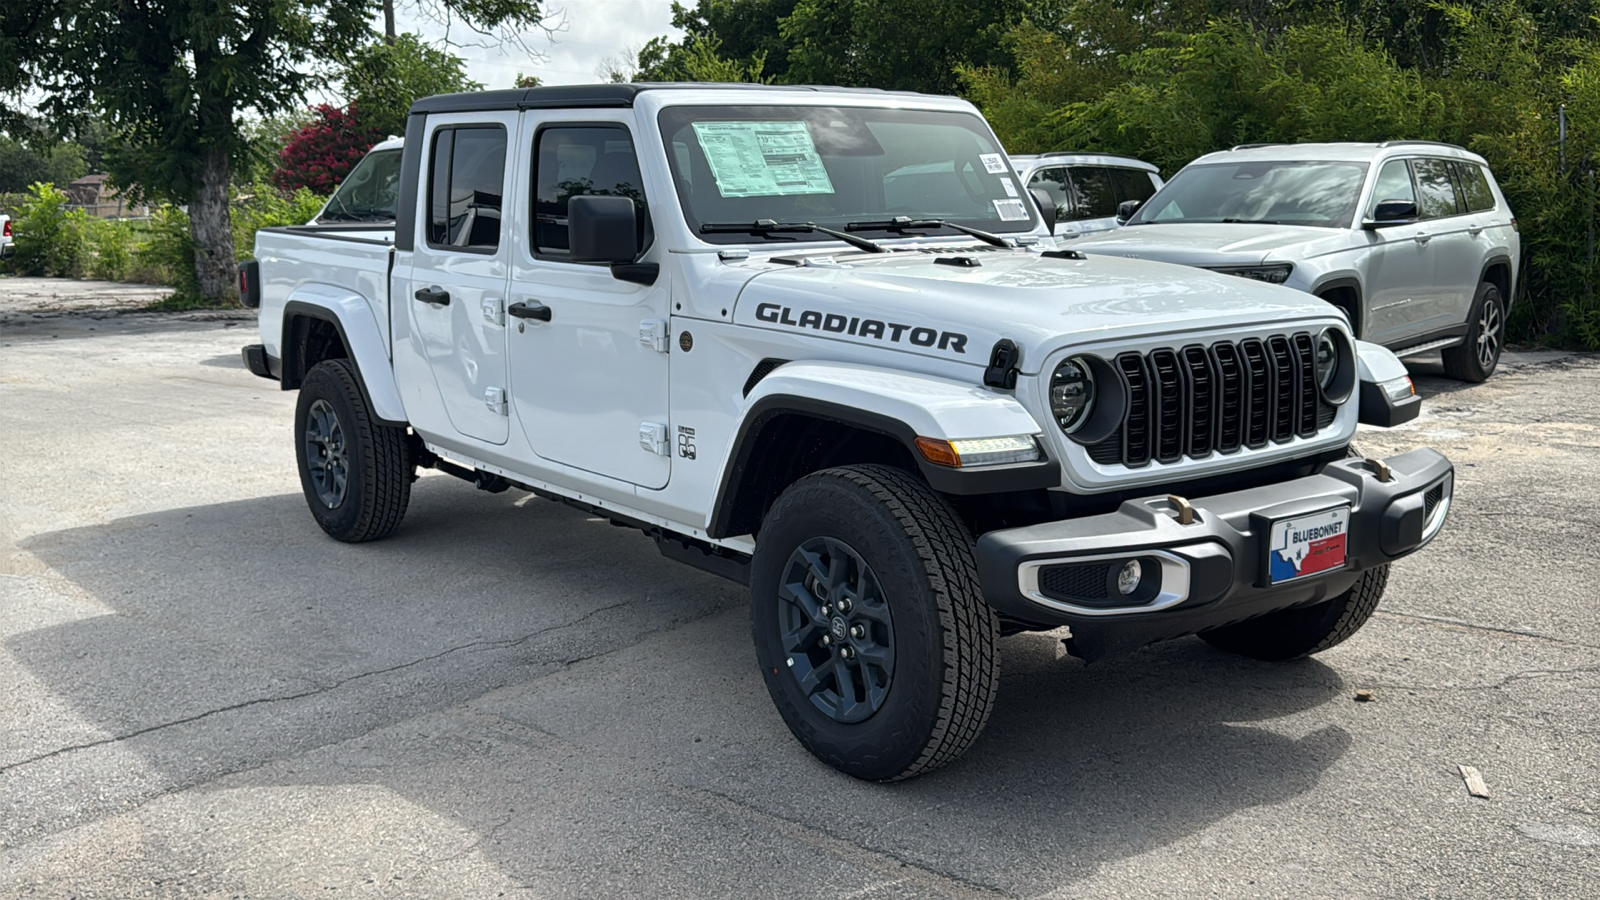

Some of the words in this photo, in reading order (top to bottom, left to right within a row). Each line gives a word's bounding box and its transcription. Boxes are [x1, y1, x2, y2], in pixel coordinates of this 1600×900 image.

[755, 302, 968, 354] GLADIATOR
[678, 433, 696, 461] 85
[1292, 521, 1343, 544] BLUEBONNET
